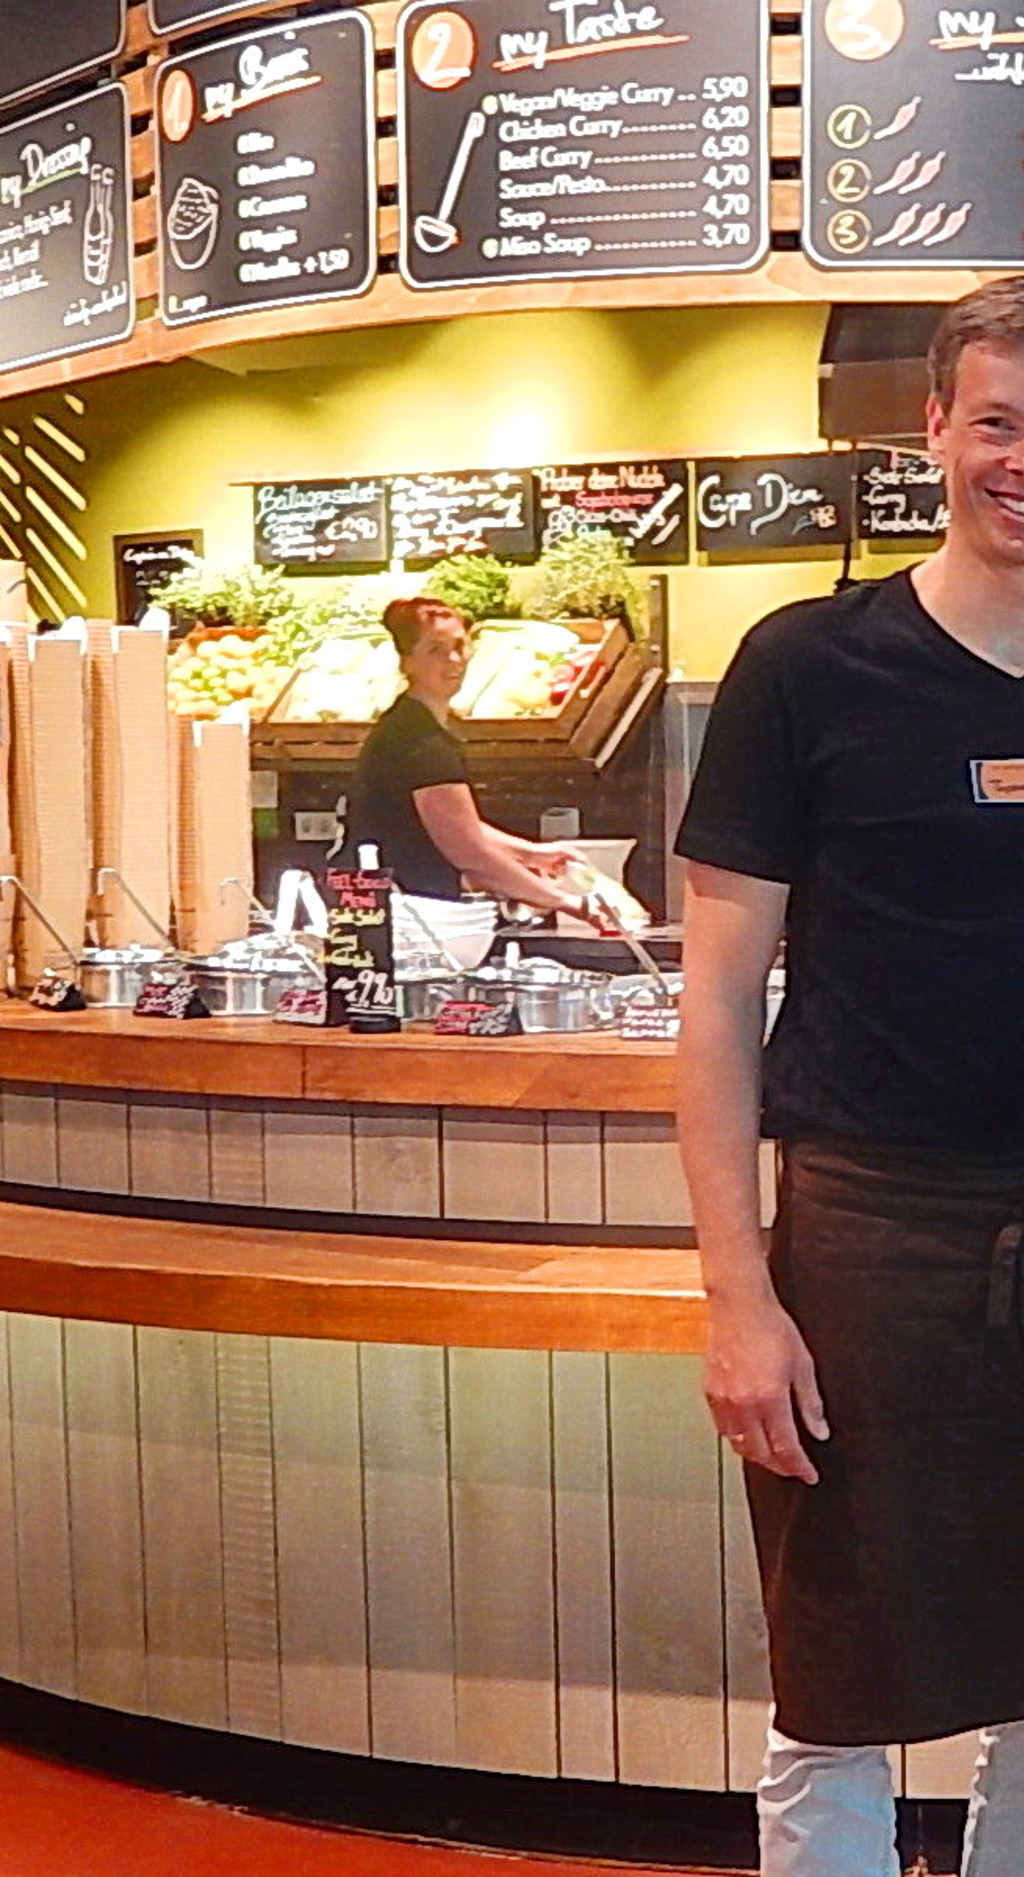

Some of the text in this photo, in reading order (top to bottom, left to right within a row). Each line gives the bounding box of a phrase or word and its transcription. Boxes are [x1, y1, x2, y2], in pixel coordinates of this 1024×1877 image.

[499, 0, 664, 68] my Taste
[938, 11, 996, 50] my
[419, 22, 471, 83] 2
[620, 82, 675, 107] Curry
[701, 76, 749, 102] 5,90
[568, 114, 624, 139] Curry
[702, 105, 750, 130] 6,20
[540, 146, 594, 170] Curry
[702, 134, 750, 160] 6,50
[702, 163, 750, 190] 4,70
[702, 193, 750, 219] 4,70
[543, 232, 592, 257] Soup
[702, 222, 750, 248] 3,70
